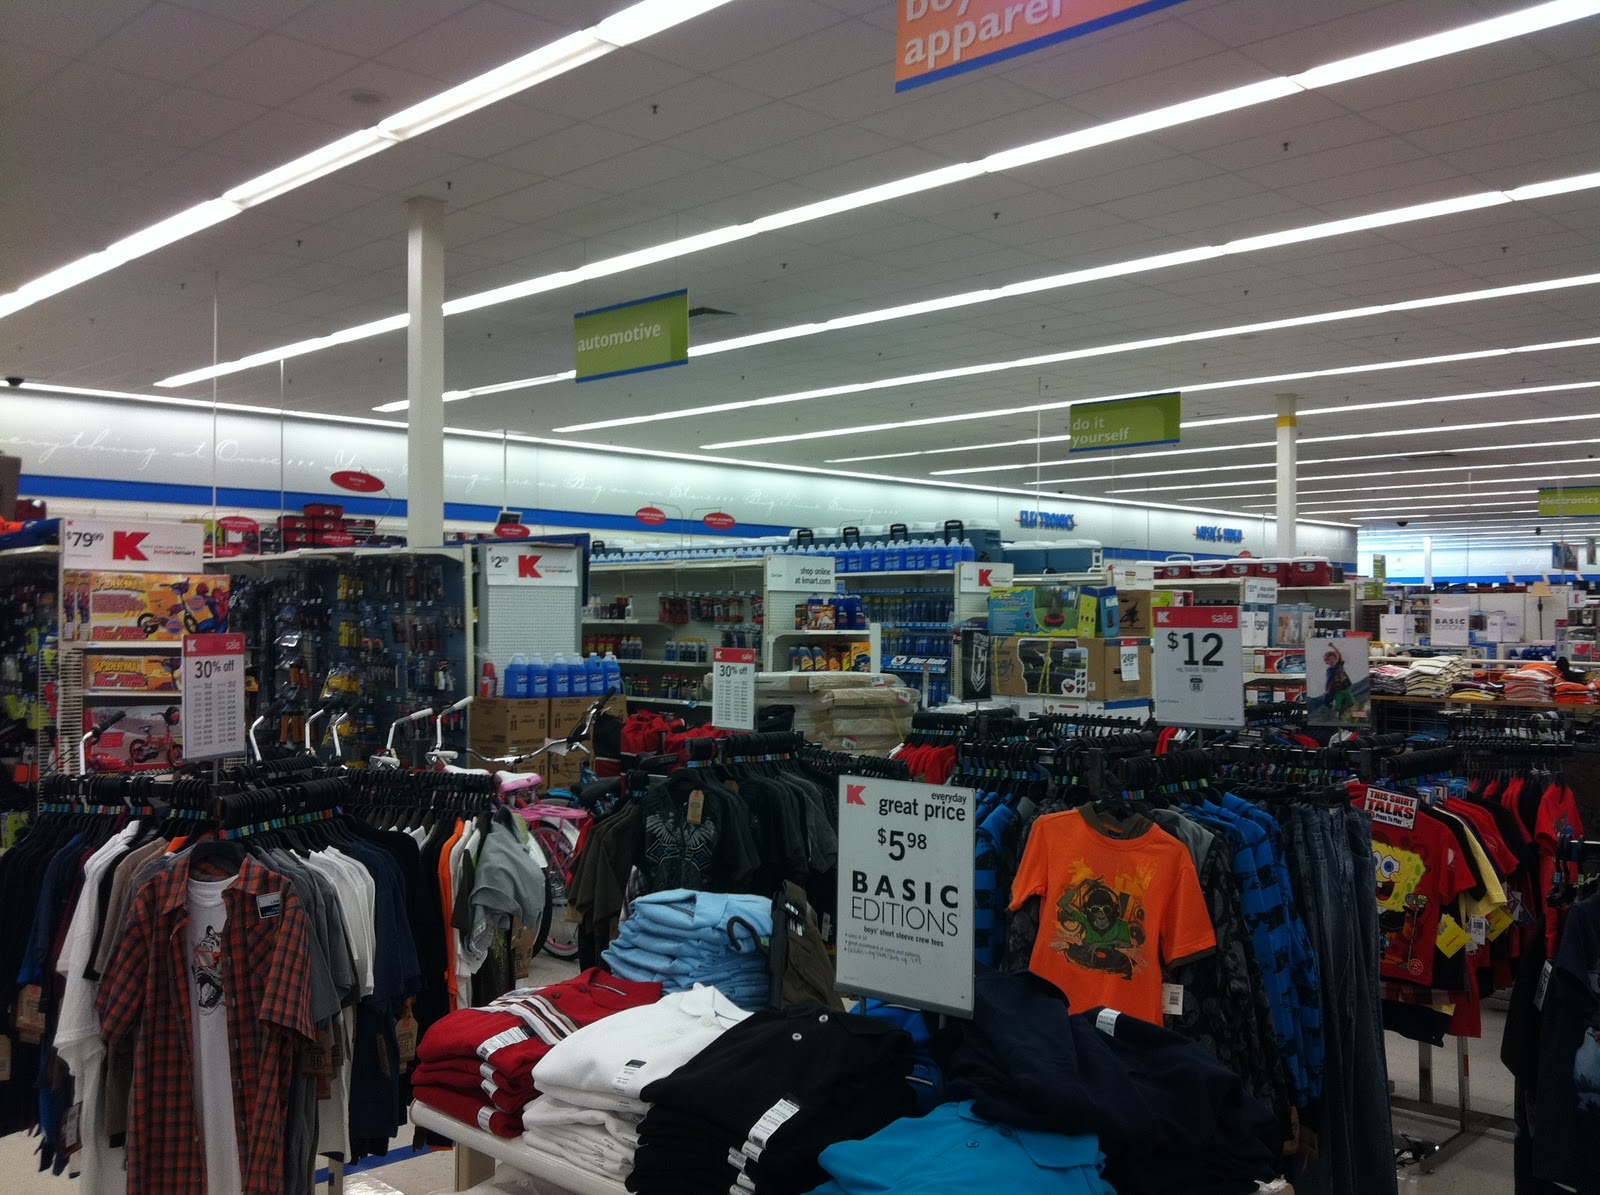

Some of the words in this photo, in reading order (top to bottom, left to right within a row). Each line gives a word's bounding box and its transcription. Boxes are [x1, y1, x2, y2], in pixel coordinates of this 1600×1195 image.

[904, 0, 1063, 69] apparel
[577, 323, 662, 353] automotive
[1072, 418, 1090, 431] do
[1094, 416, 1106, 429] it
[1071, 427, 1130, 449] yourself
[1211, 613, 1233, 624] sale
[226, 641, 240, 650] sale
[1167, 631, 1224, 667] $12
[195, 660, 221, 678] 30%
[223, 660, 235, 672] off
[719, 664, 737, 677] 30%
[739, 665, 748, 675] off
[931, 791, 967, 804] everyday
[1369, 790, 1388, 804] THIS
[1389, 793, 1415, 807] SHIRT
[878, 798, 919, 816] great
[924, 801, 966, 821] price
[1366, 798, 1415, 820] TALKS
[1375, 813, 1388, 822] Press
[1387, 815, 1393, 823] To
[1393, 816, 1403, 826] Play
[852, 870, 959, 909] BASIC
[851, 896, 958, 937] EDITIONS
[879, 927, 895, 938] short
[895, 930, 915, 942] sleeve
[915, 935, 930, 945] crew
[931, 938, 944, 947] tees
